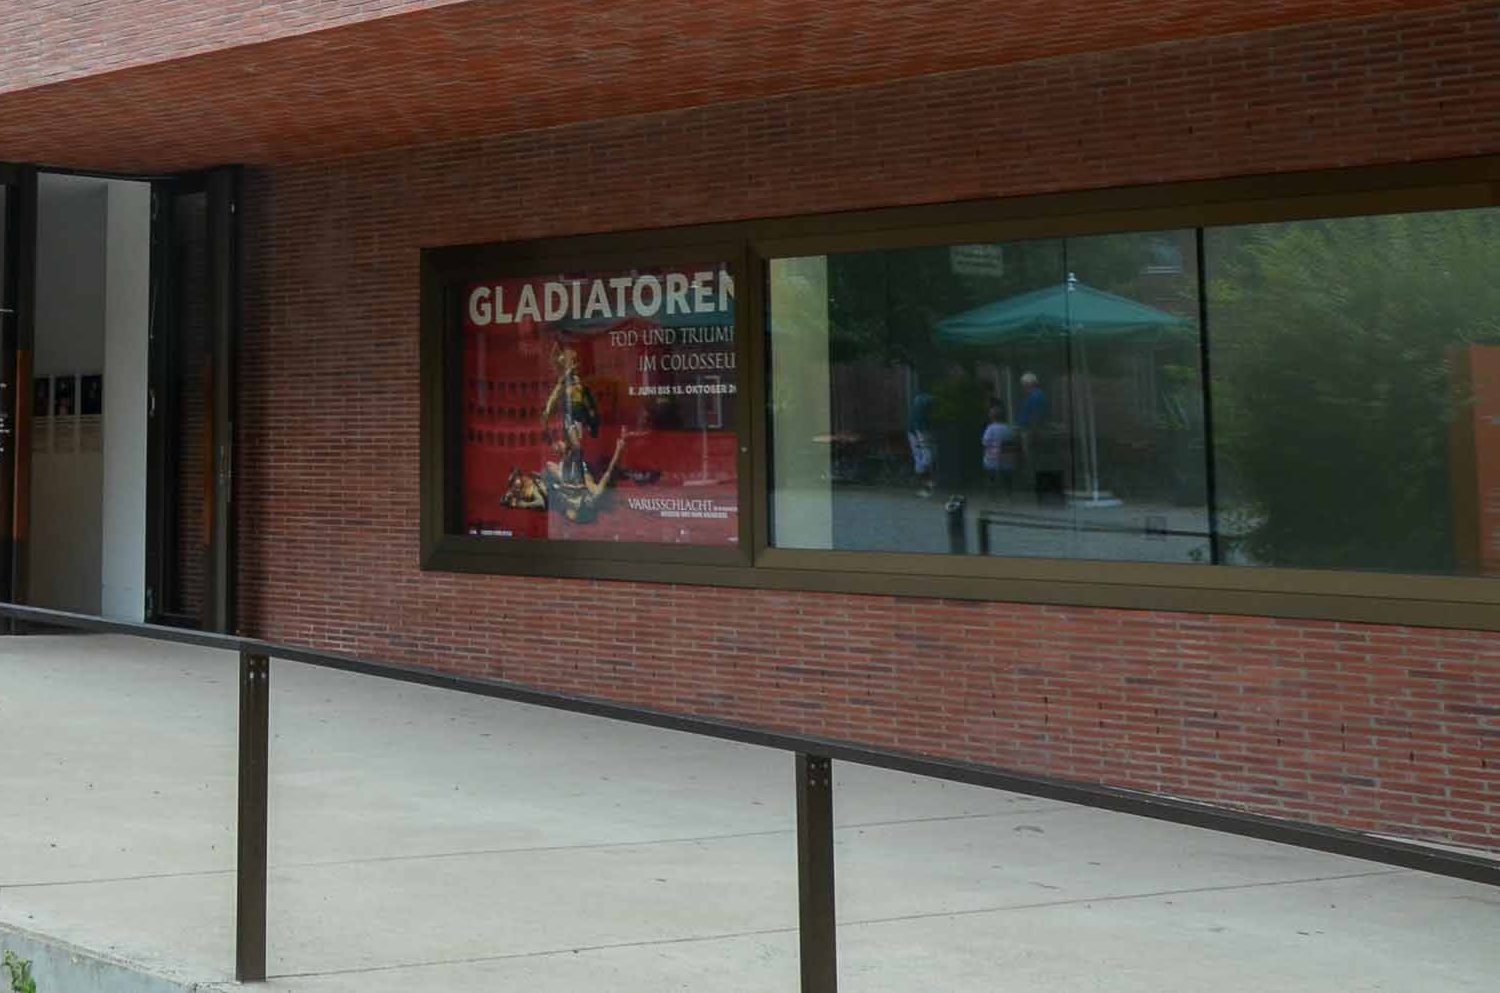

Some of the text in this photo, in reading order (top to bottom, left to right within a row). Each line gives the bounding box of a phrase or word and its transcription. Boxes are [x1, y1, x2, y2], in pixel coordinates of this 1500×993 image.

[610, 330, 638, 347] TOD
[643, 328, 676, 346] UND
[639, 354, 657, 372] IM
[628, 497, 714, 511] VARUSSCHLACHT
